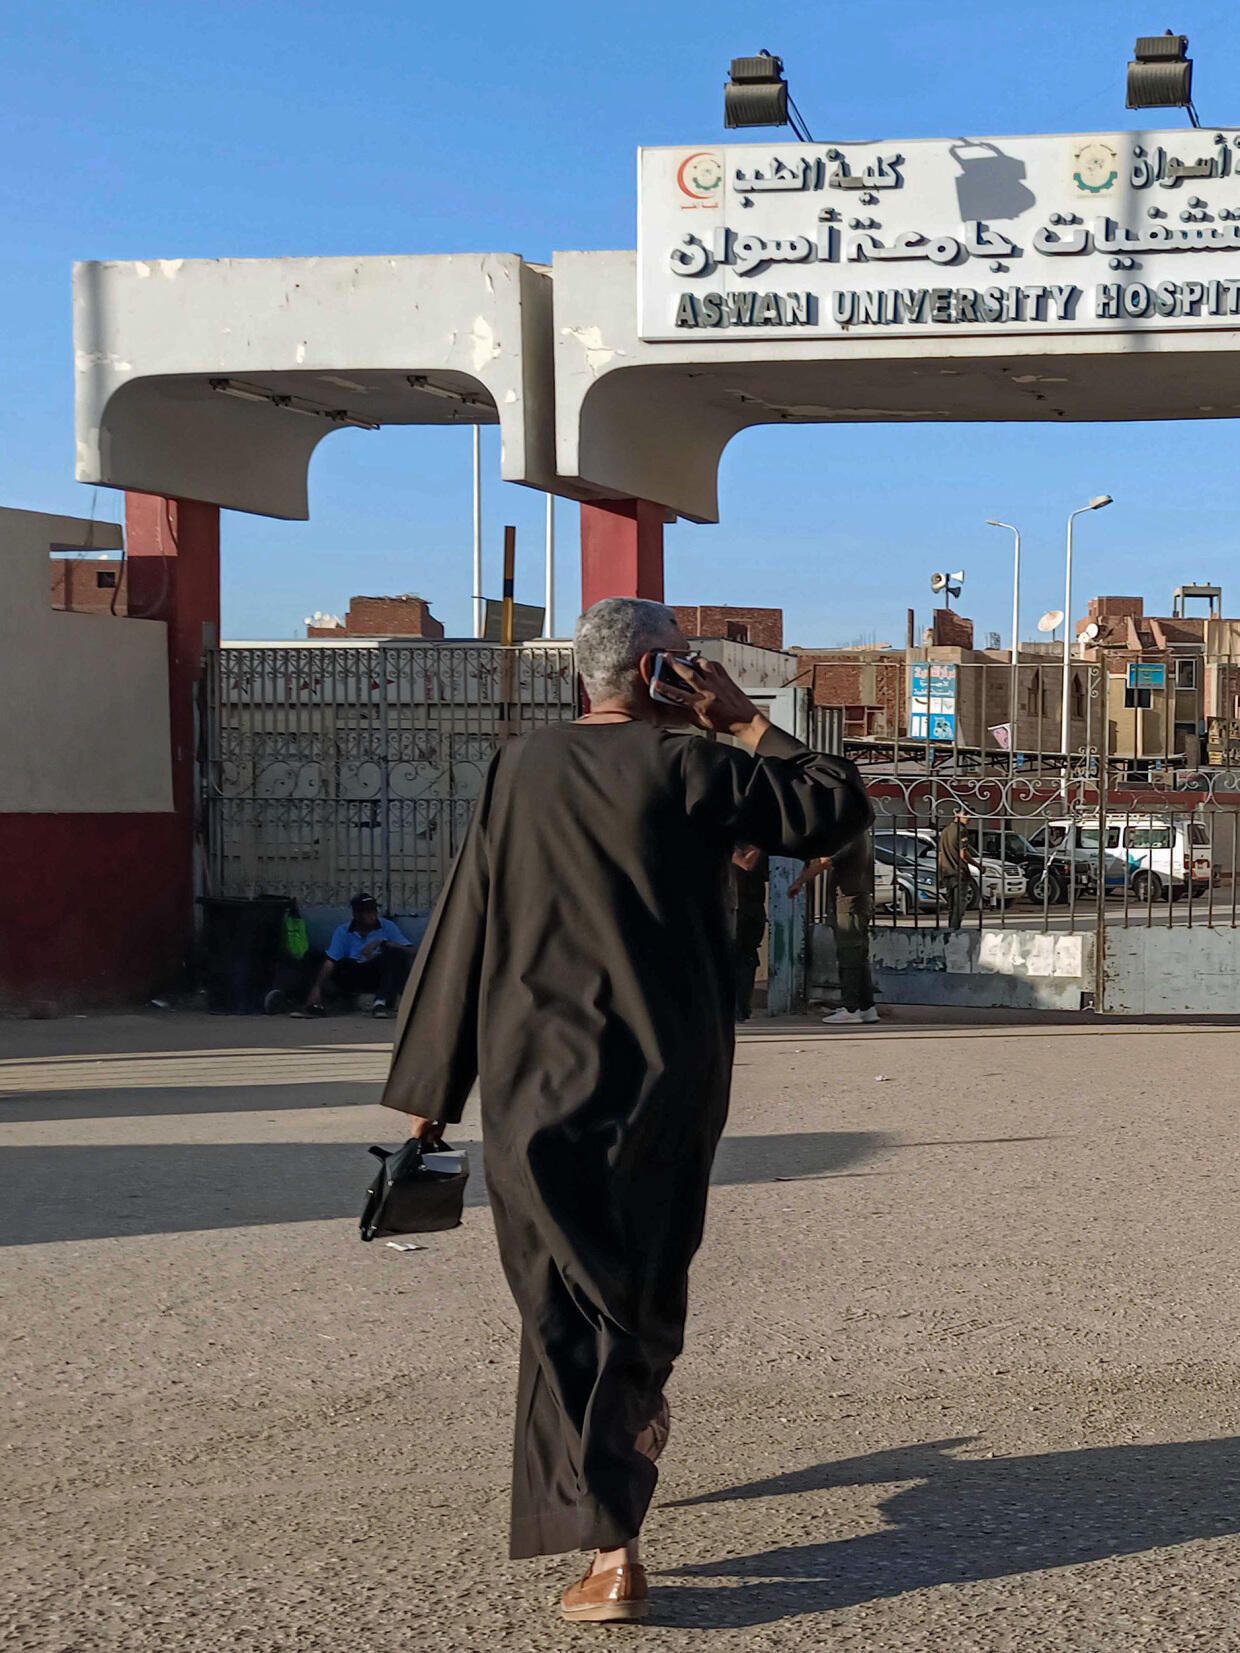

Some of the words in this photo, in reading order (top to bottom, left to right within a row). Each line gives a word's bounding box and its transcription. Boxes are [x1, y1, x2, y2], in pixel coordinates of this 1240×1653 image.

[732, 156, 824, 208] الطب
[828, 148, 904, 205] كلية
[670, 207, 840, 278] أسوان
[848, 216, 1018, 273] جامعة
[675, 291, 816, 328] ASWAN
[832, 284, 1076, 326] UNIVERSITY
